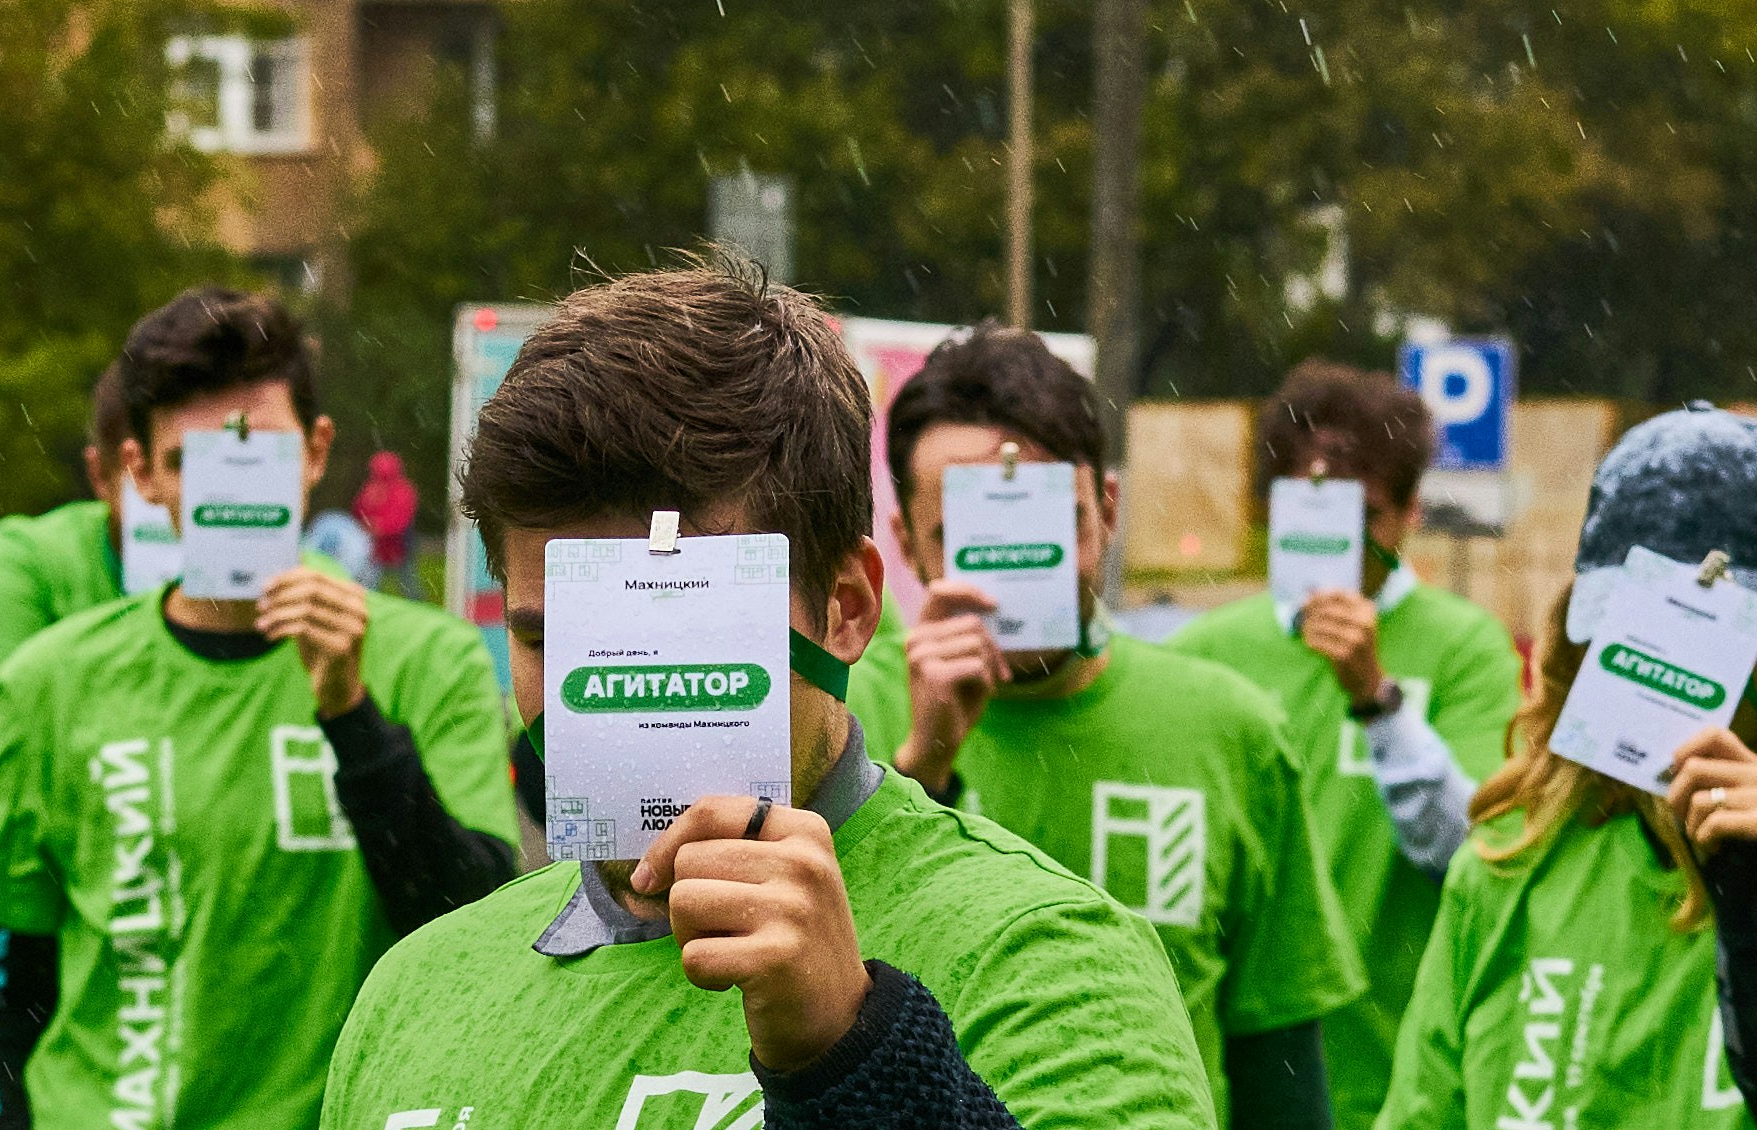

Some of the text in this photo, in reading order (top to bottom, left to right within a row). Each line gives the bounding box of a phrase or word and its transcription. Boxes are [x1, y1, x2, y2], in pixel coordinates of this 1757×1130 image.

[624, 577, 710, 591] Махницкий
[588, 649, 625, 659] Добрый
[626, 650, 651, 658] день,
[1611, 649, 1717, 699] АГИТАТОР
[583, 671, 750, 699] АГИТАТОР
[651, 721, 692, 730] команды
[693, 720, 750, 730] Махницкого
[640, 804, 692, 818] НОВЫ
